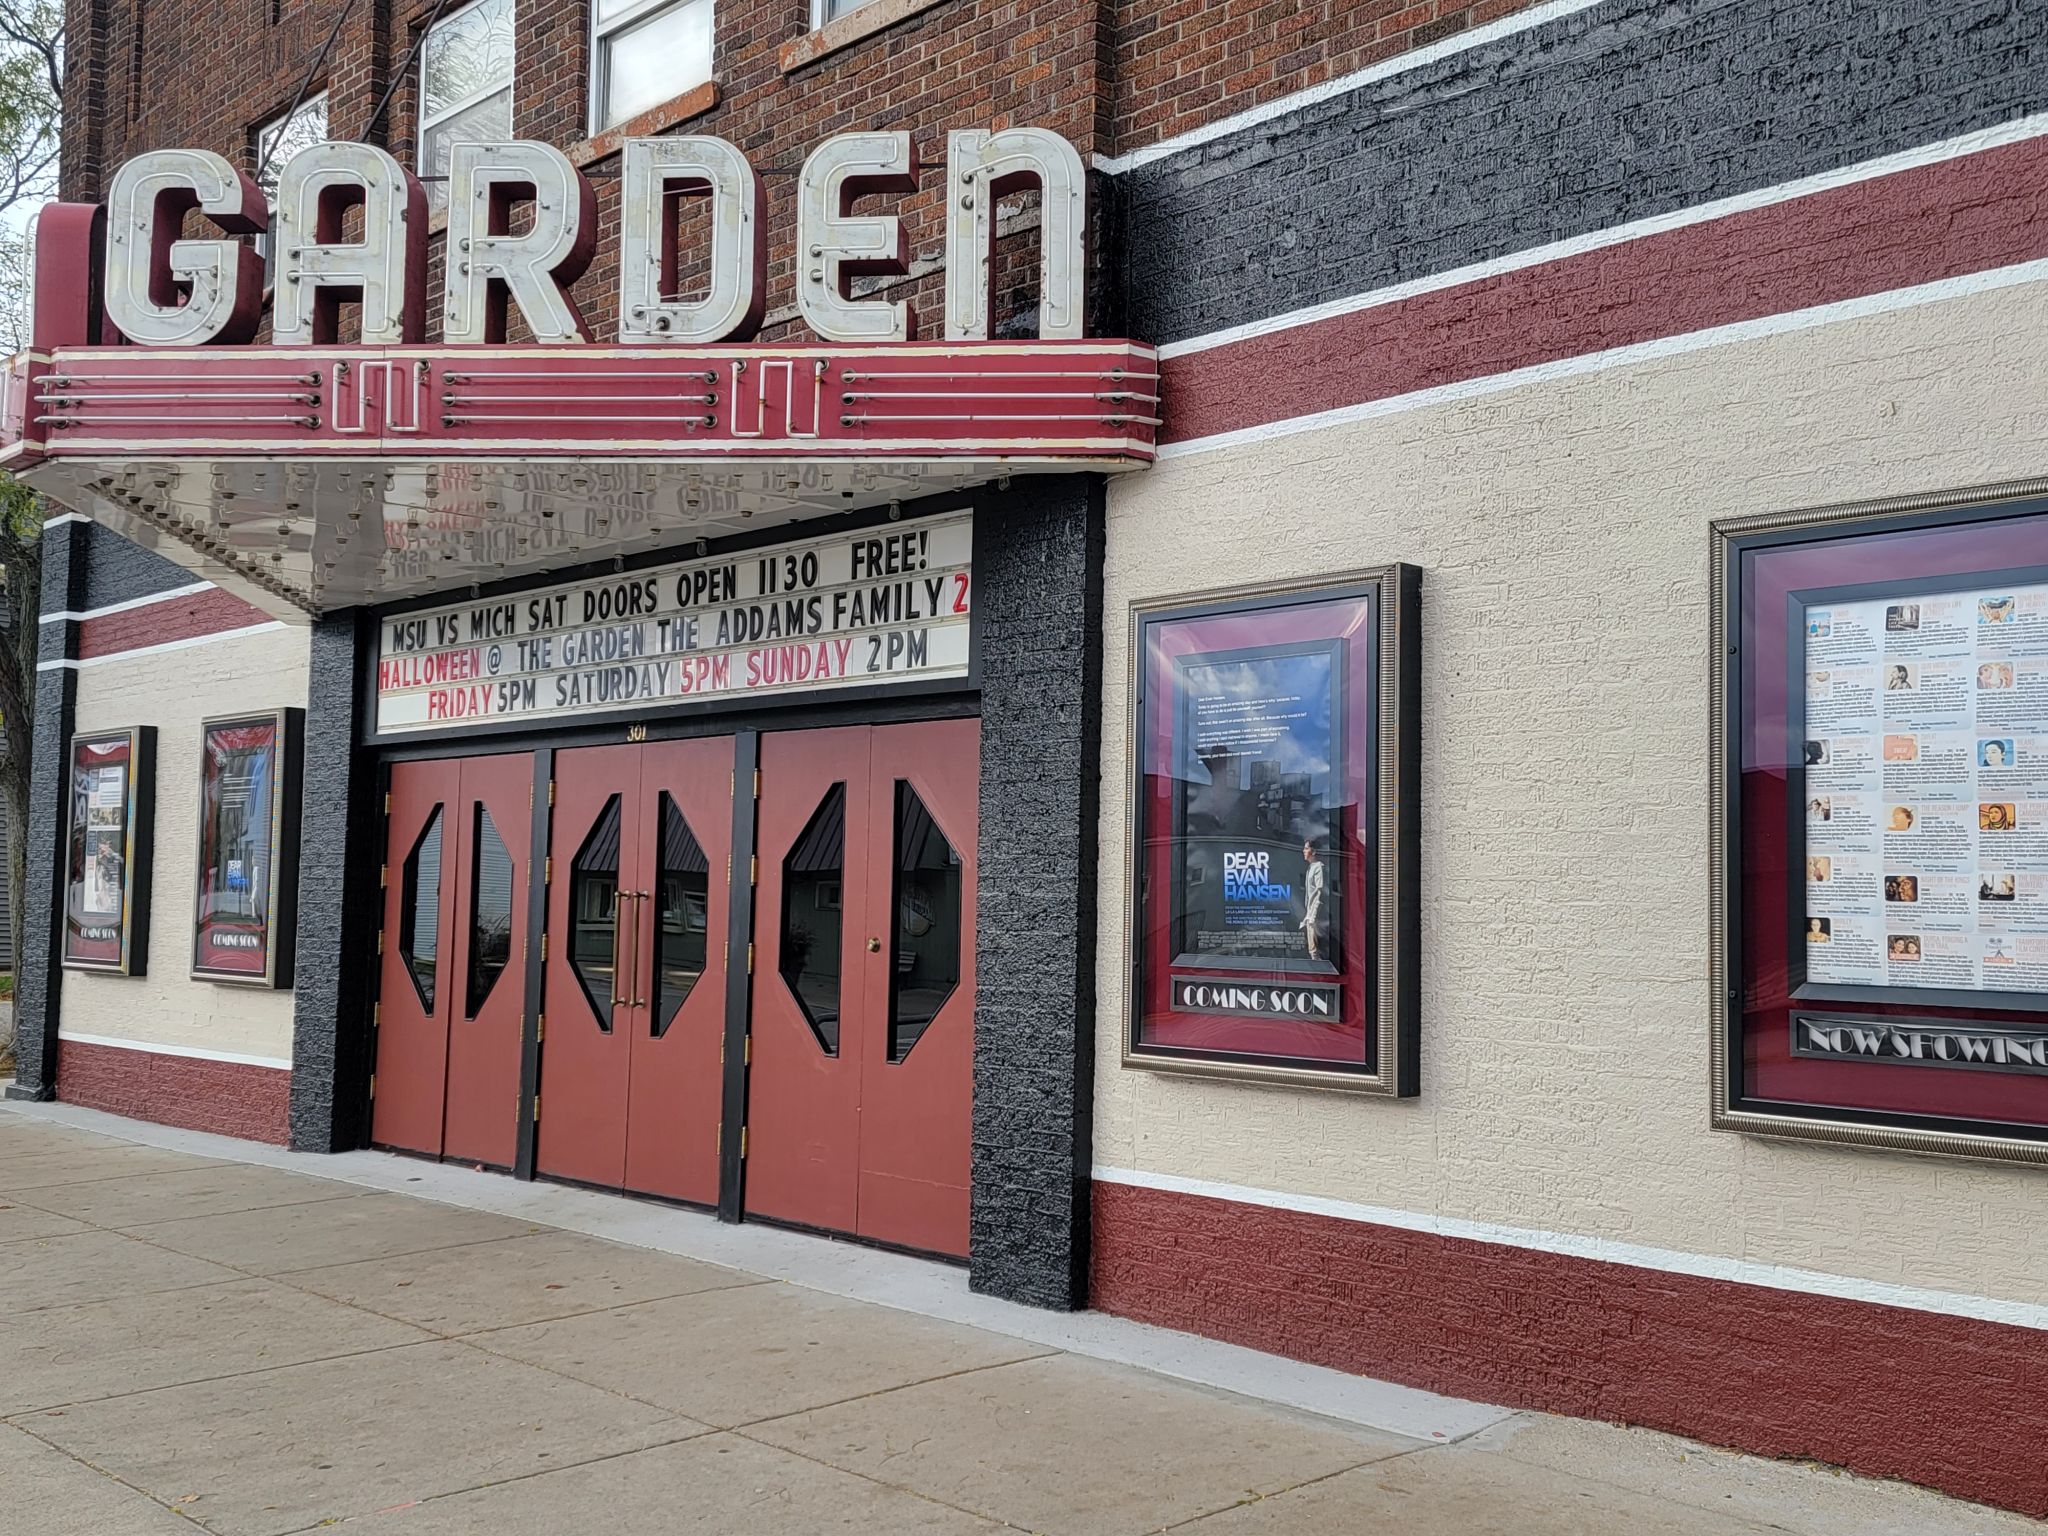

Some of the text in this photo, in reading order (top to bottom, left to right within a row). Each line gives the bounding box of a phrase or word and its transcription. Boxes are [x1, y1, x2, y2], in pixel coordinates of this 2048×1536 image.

[104, 128, 1086, 346] GARDEN
[393, 530, 928, 652] MSU VS MICH SAT DOORS OPEN 1130 FREE!
[379, 573, 969, 690] HALLOWEEN @ THE GARDEN THE ADDAMS FAMILY 2
[428, 628, 928, 720] FRIDAY 5PM SATURDAY 5PM SUNDAY 2PM
[626, 724, 647, 742] 301
[1223, 851, 1270, 869] DEAR
[1224, 868, 1269, 886] EVAN
[1224, 884, 1291, 901] HANSEN
[1183, 985, 1328, 1015] COMING SOON
[1808, 1028, 1887, 1057] NOW
